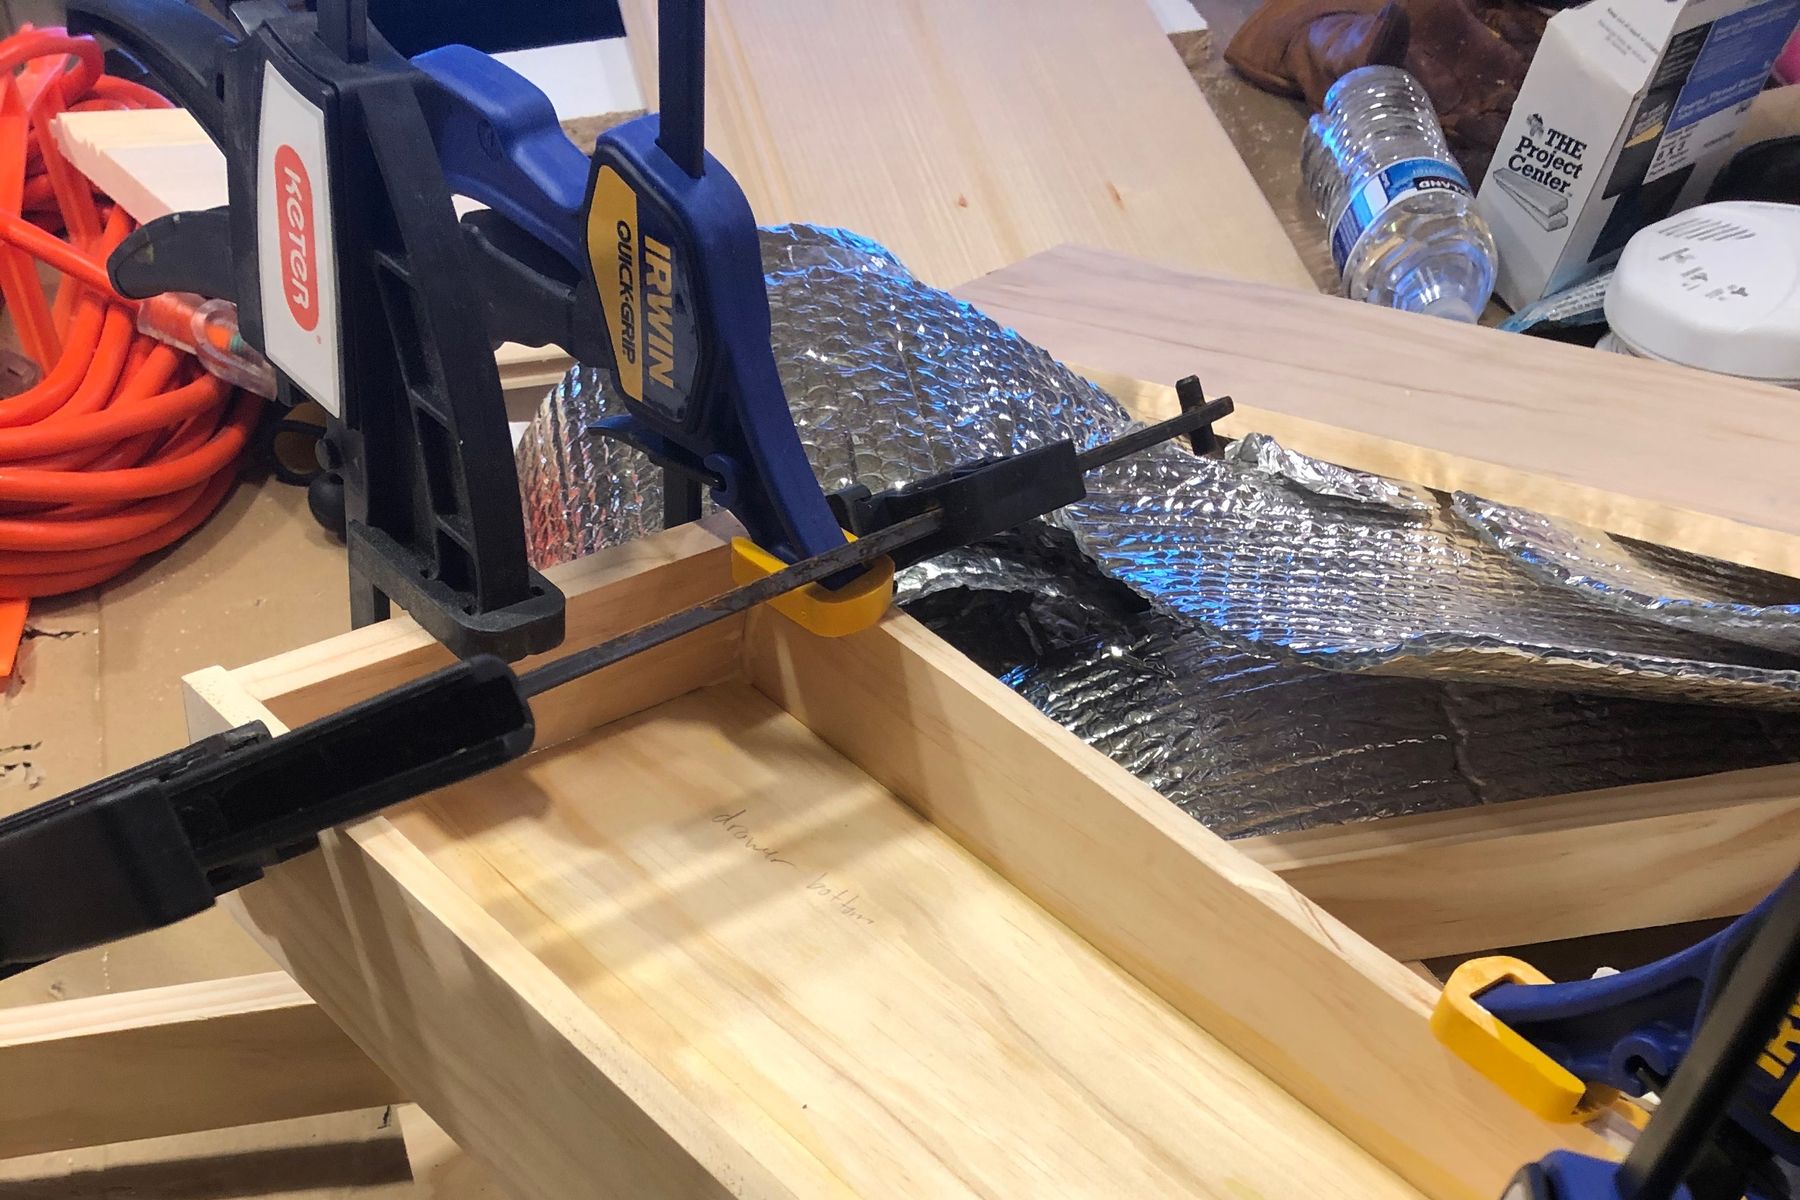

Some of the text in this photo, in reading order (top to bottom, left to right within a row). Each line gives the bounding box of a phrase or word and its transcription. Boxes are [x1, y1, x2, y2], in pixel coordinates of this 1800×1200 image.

[1514, 136, 1583, 179] Project
[1544, 128, 1588, 161] THE
[1507, 154, 1571, 193] Center
[644, 234, 675, 389] IRWIN
